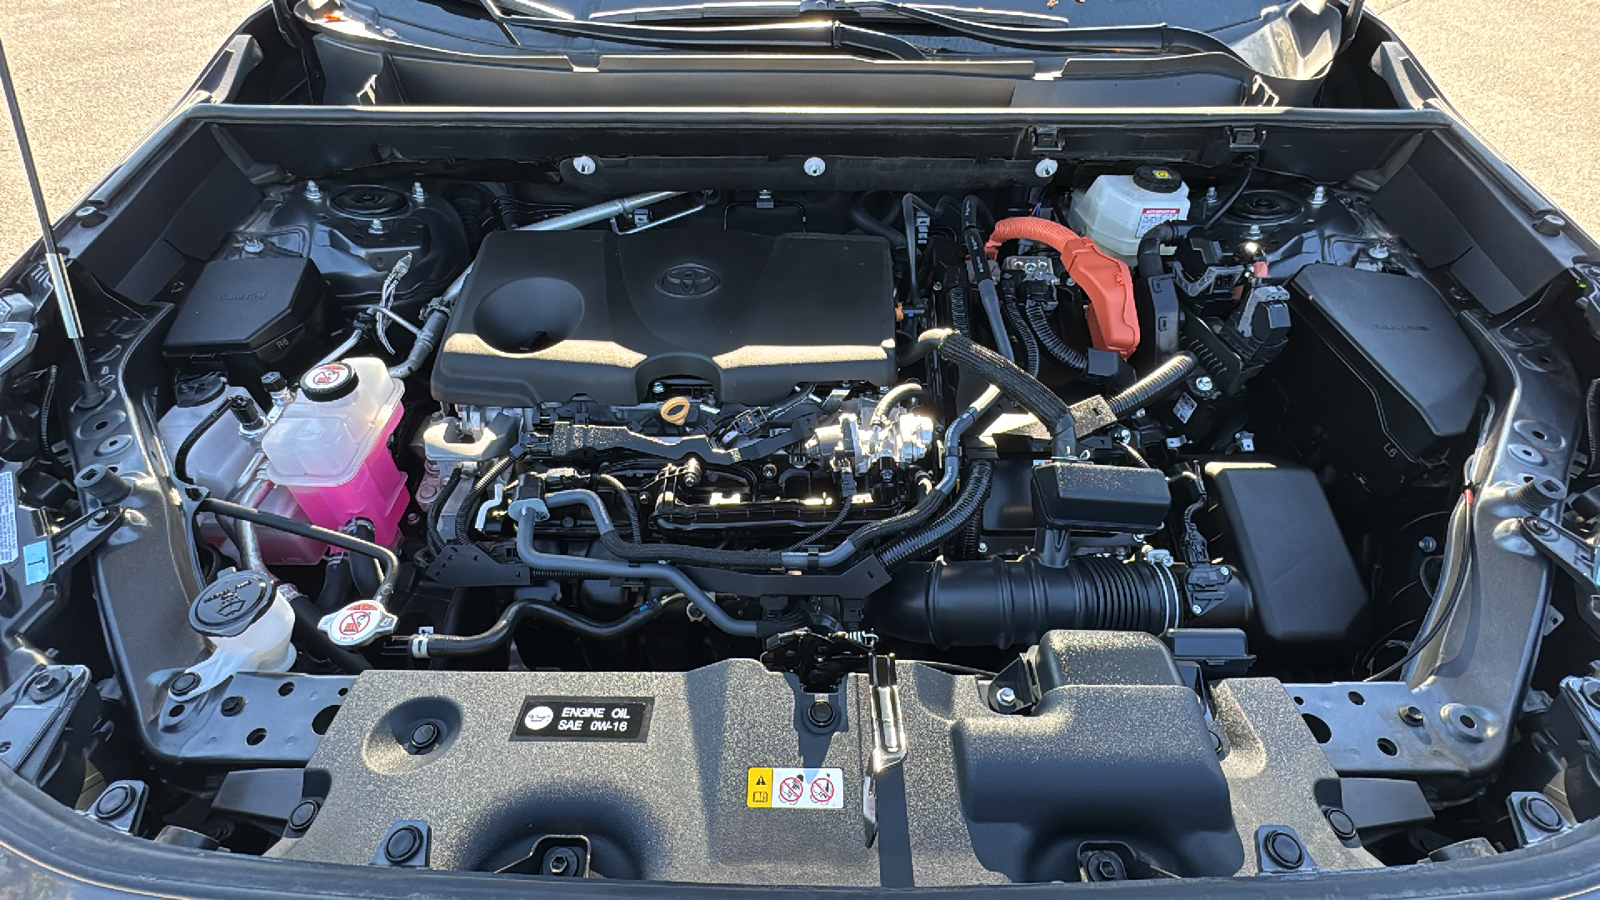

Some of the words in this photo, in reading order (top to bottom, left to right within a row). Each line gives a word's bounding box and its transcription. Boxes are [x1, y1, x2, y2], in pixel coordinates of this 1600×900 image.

[276, 338, 289, 350] R6
[1383, 442, 1397, 457] L6
[561, 707, 605, 718] ENGINE
[611, 708, 631, 719] OIL
[557, 719, 584, 731] SAE
[590, 720, 628, 732] 0W-16
